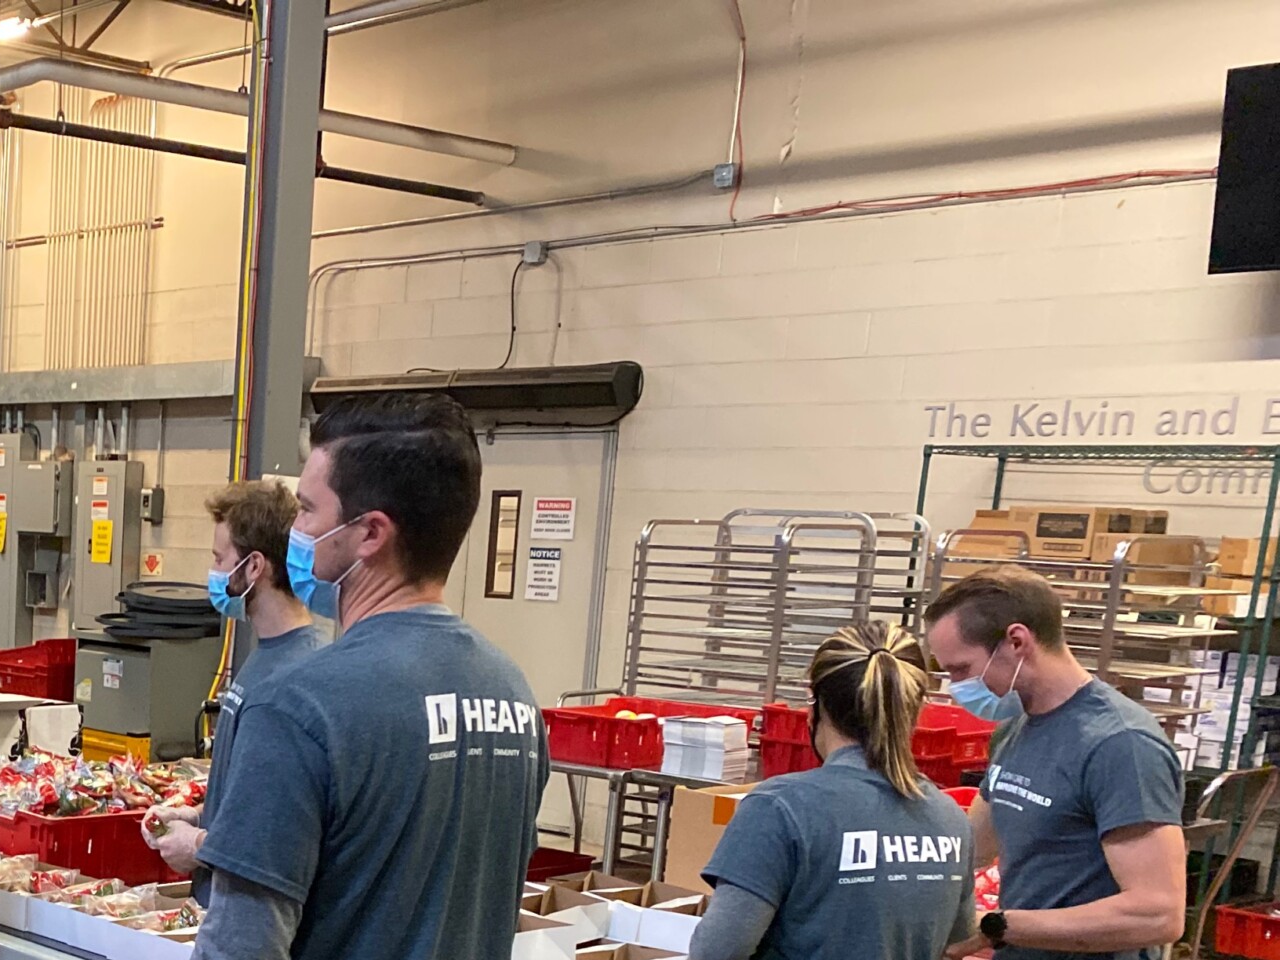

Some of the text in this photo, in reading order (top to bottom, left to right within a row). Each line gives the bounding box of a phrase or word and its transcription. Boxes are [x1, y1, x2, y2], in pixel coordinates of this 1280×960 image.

[924, 402, 991, 437] The
[1009, 400, 1135, 437] Kelvin
[1155, 398, 1239, 435] and
[538, 502, 571, 510] WARNING
[530, 550, 560, 559] NOTICE
[462, 699, 537, 737] HEAPY
[882, 835, 961, 863] HEAPY
